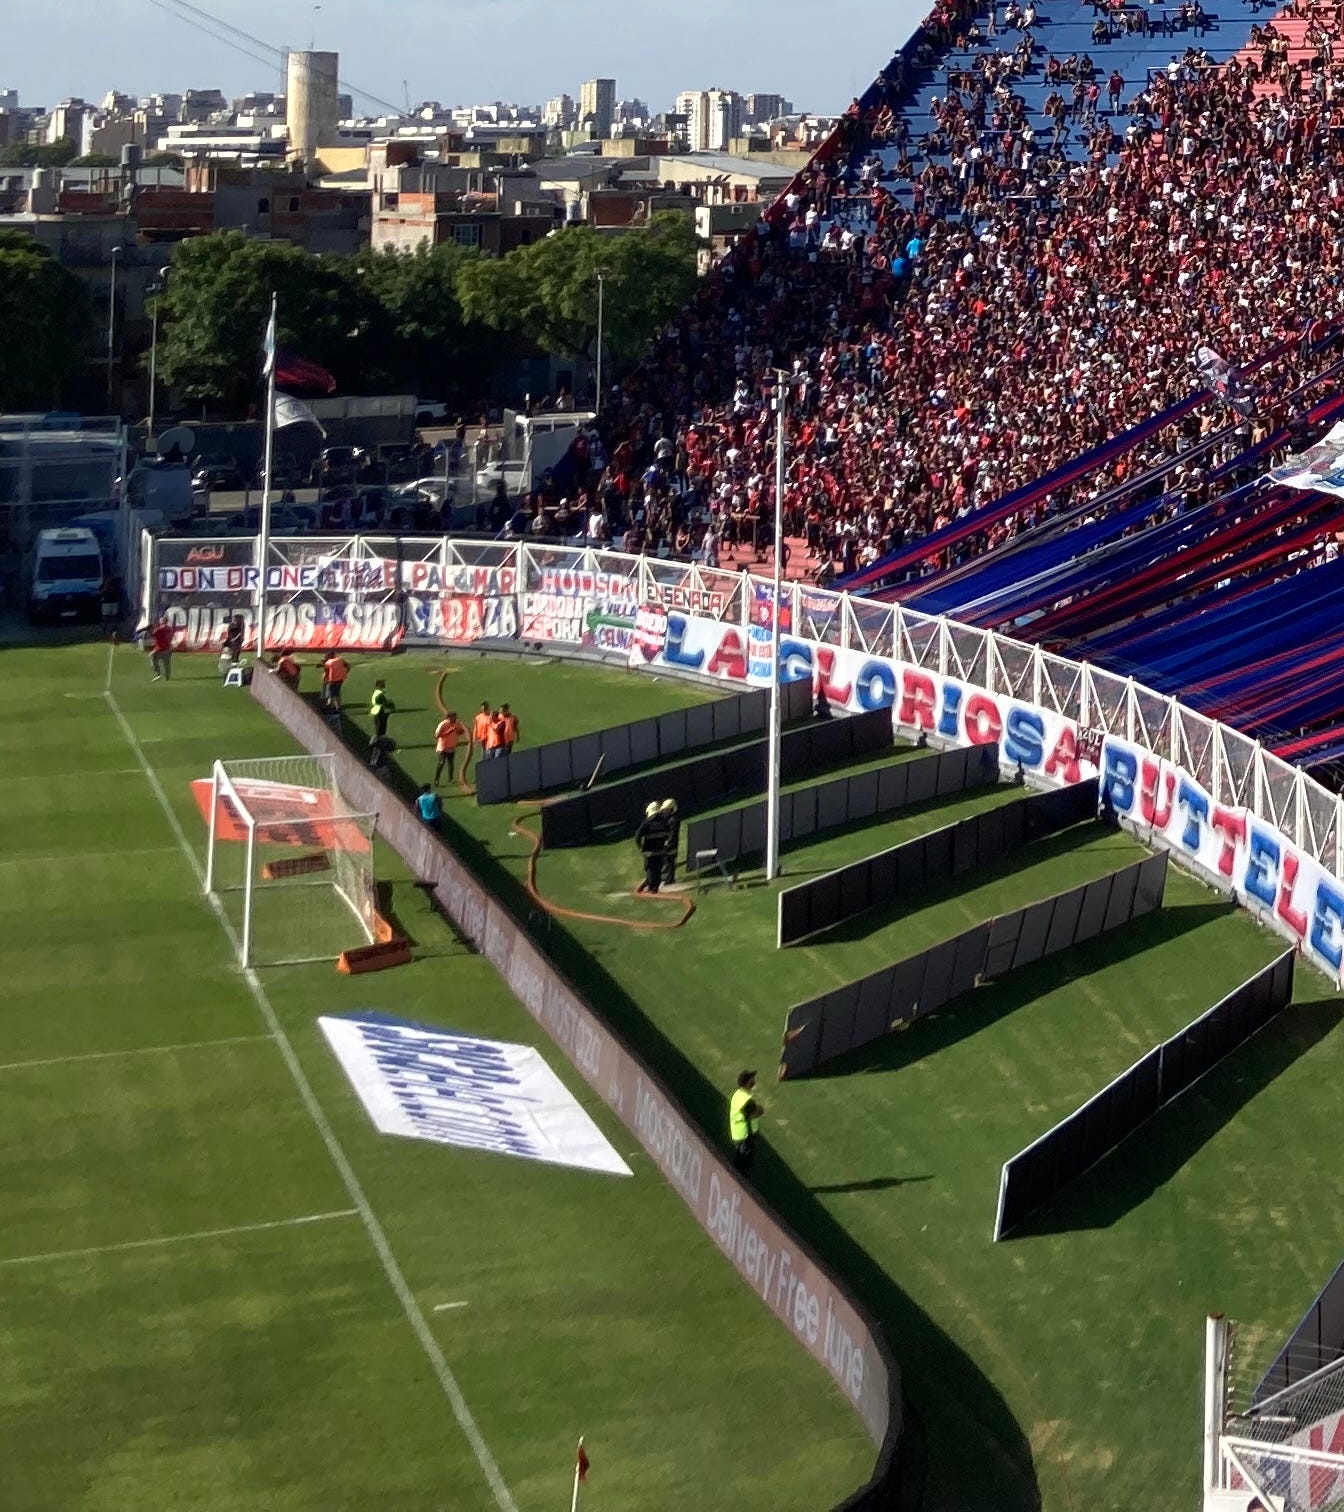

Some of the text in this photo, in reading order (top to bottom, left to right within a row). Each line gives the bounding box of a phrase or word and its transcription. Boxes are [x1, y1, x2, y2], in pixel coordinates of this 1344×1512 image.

[160, 568, 216, 589] DON
[227, 566, 317, 589] ORONE
[542, 569, 638, 601] HUDSON
[648, 584, 724, 612] ENSENADA
[663, 614, 749, 679] LA
[780, 632, 1081, 785] GLORIOSA
[776, 1251, 820, 1345] Free
